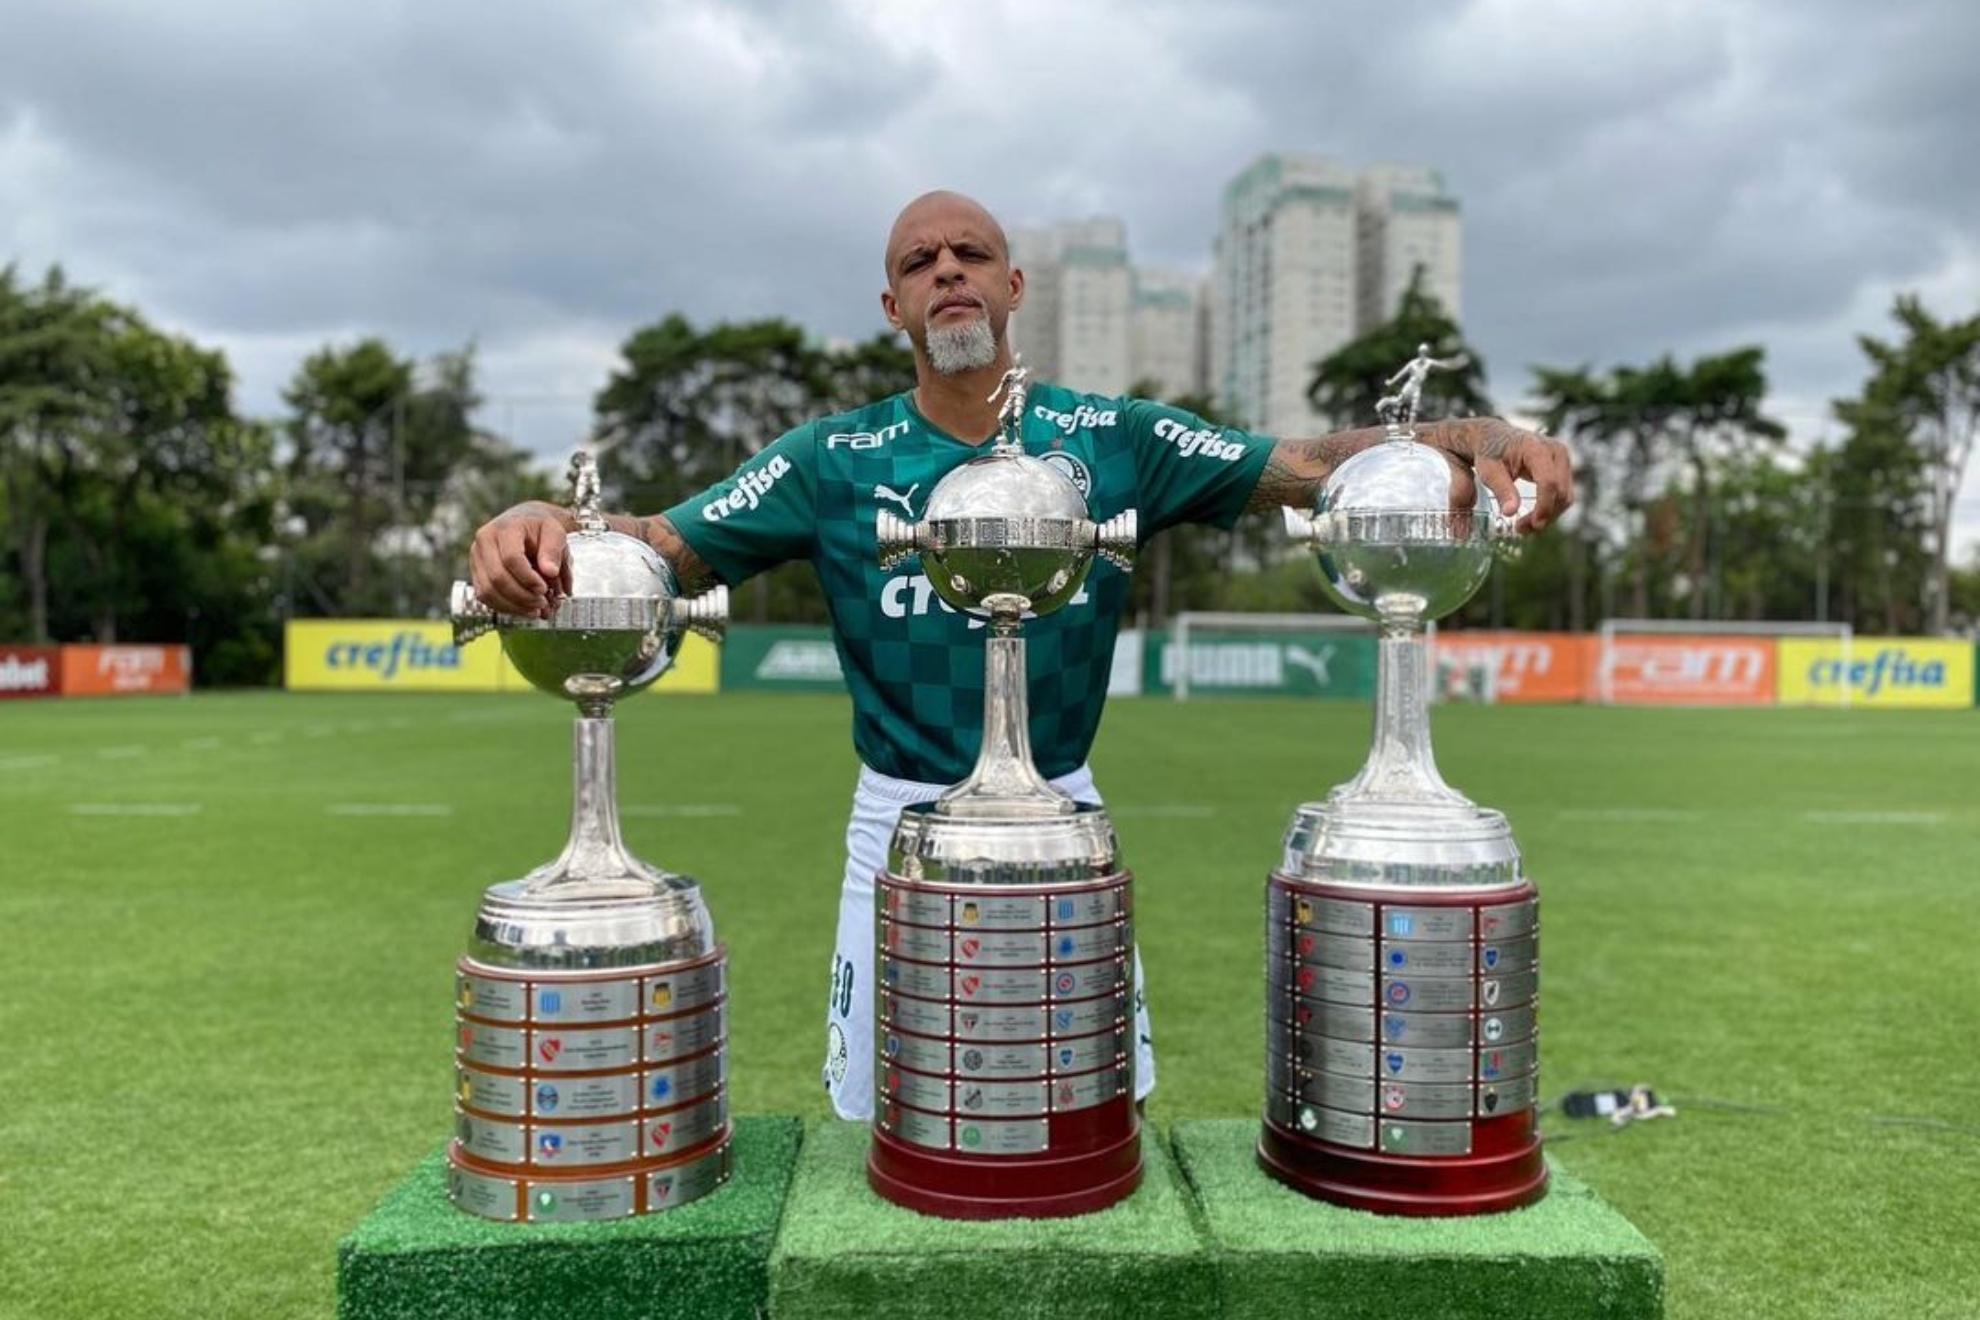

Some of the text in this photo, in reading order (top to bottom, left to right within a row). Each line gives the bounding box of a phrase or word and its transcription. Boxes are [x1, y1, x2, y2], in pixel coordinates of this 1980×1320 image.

[1034, 404, 1117, 434] crefisa
[1153, 418, 1247, 461] crefisa
[702, 454, 792, 521] crefisa
[325, 631, 461, 680] crefisa
[1807, 648, 1945, 696] crefisa
